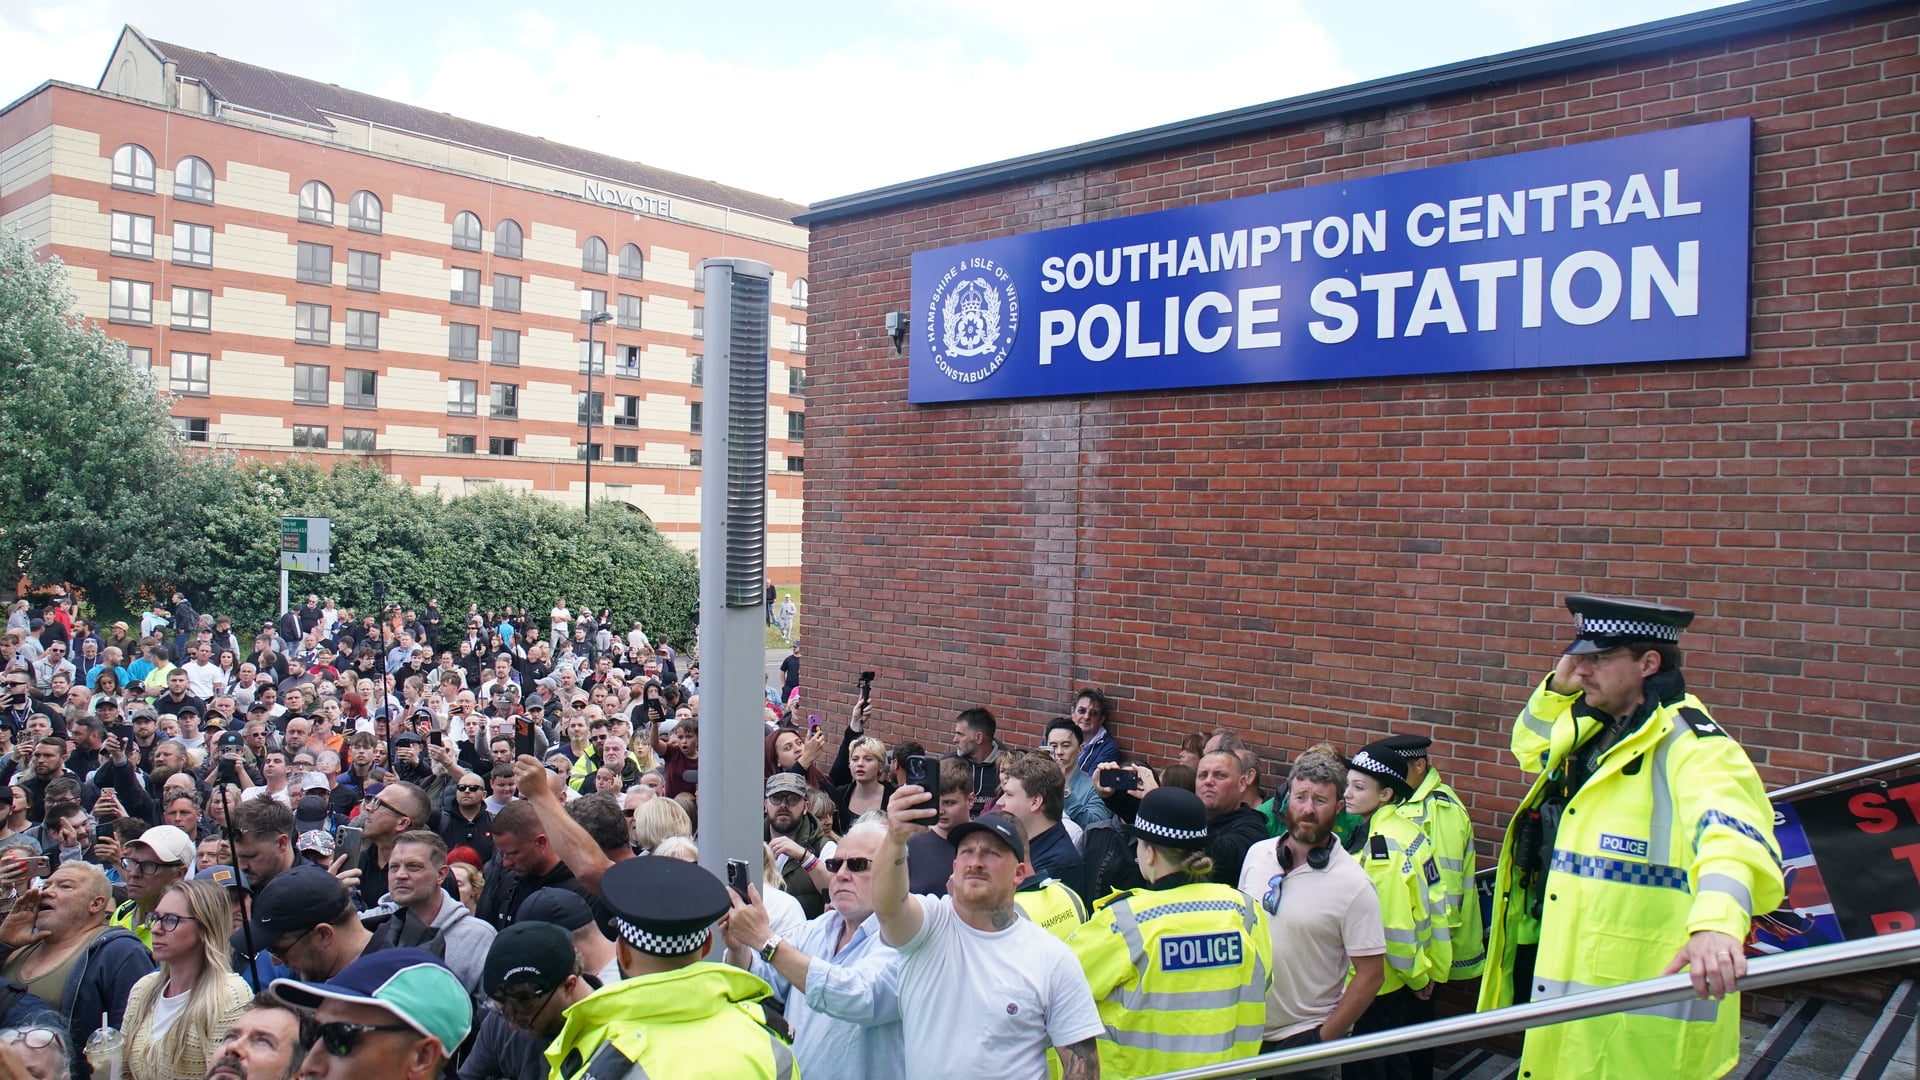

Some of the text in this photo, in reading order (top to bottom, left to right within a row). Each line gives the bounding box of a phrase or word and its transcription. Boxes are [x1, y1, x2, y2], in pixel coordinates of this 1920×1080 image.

[583, 179, 681, 220] NOVOTEL
[1041, 168, 1702, 293] SOUTHAMPTON CENTRAL
[927, 257, 1018, 342] HAMPSHIRE & ISLE OF WIGHT
[1039, 240, 1700, 366] POLICE STATION
[935, 347, 1007, 383] CONSTABULARY
[1602, 836, 1646, 855] POLICE
[1041, 908, 1075, 929] HAMPSHIRE
[1164, 935, 1240, 967] POLICE
